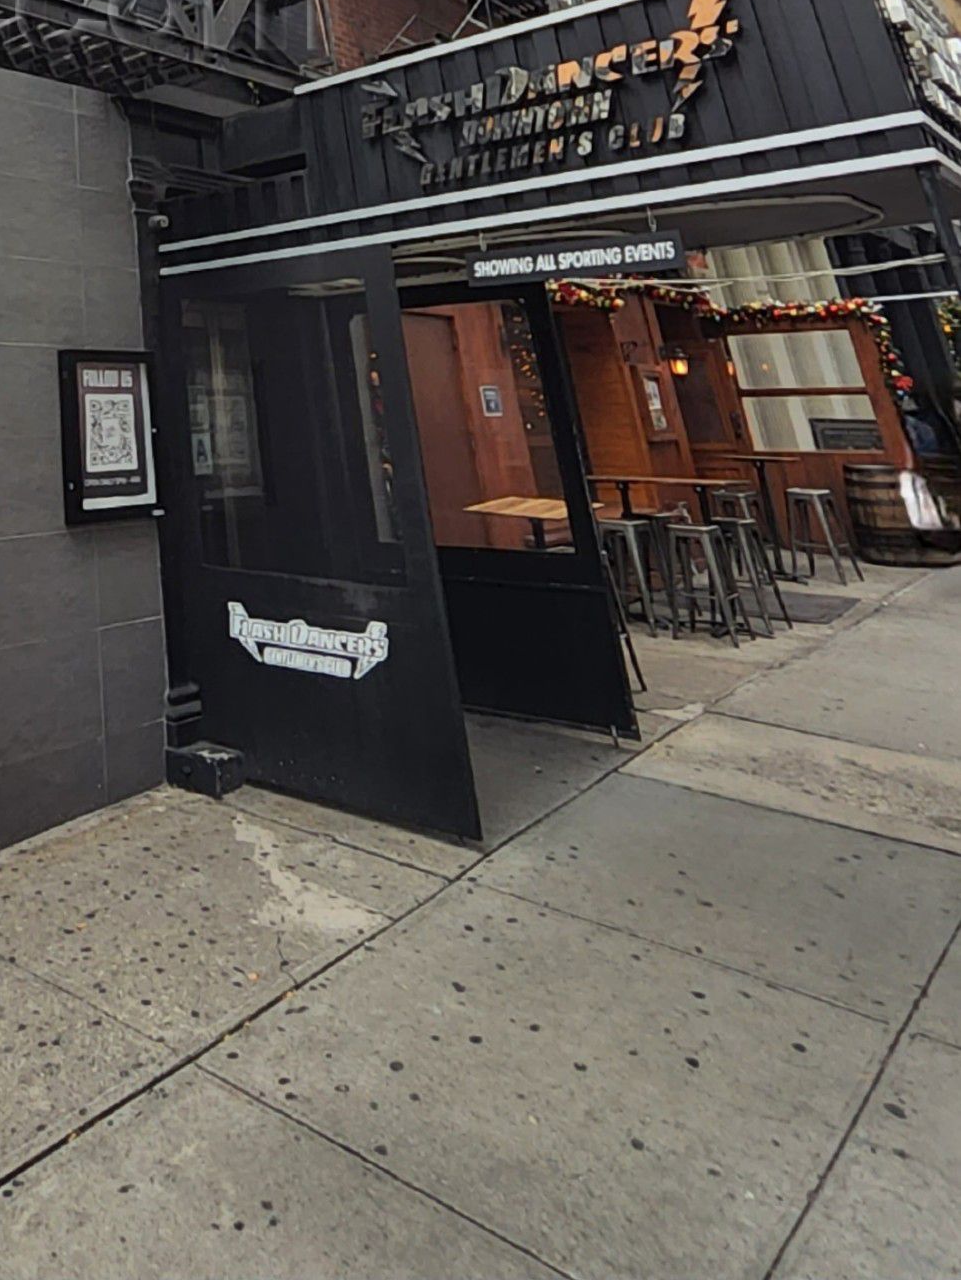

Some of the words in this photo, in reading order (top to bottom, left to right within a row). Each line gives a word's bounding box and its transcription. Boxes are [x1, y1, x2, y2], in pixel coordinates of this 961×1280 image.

[460, 89, 613, 148] DOWNTOWN
[420, 131, 593, 185] GENTLEMEN'S
[609, 112, 686, 150] CLUB
[473, 255, 534, 278] SHOWING
[535, 253, 557, 272] ALL
[558, 246, 623, 270] SPORTING
[624, 241, 676, 263] EVENTS
